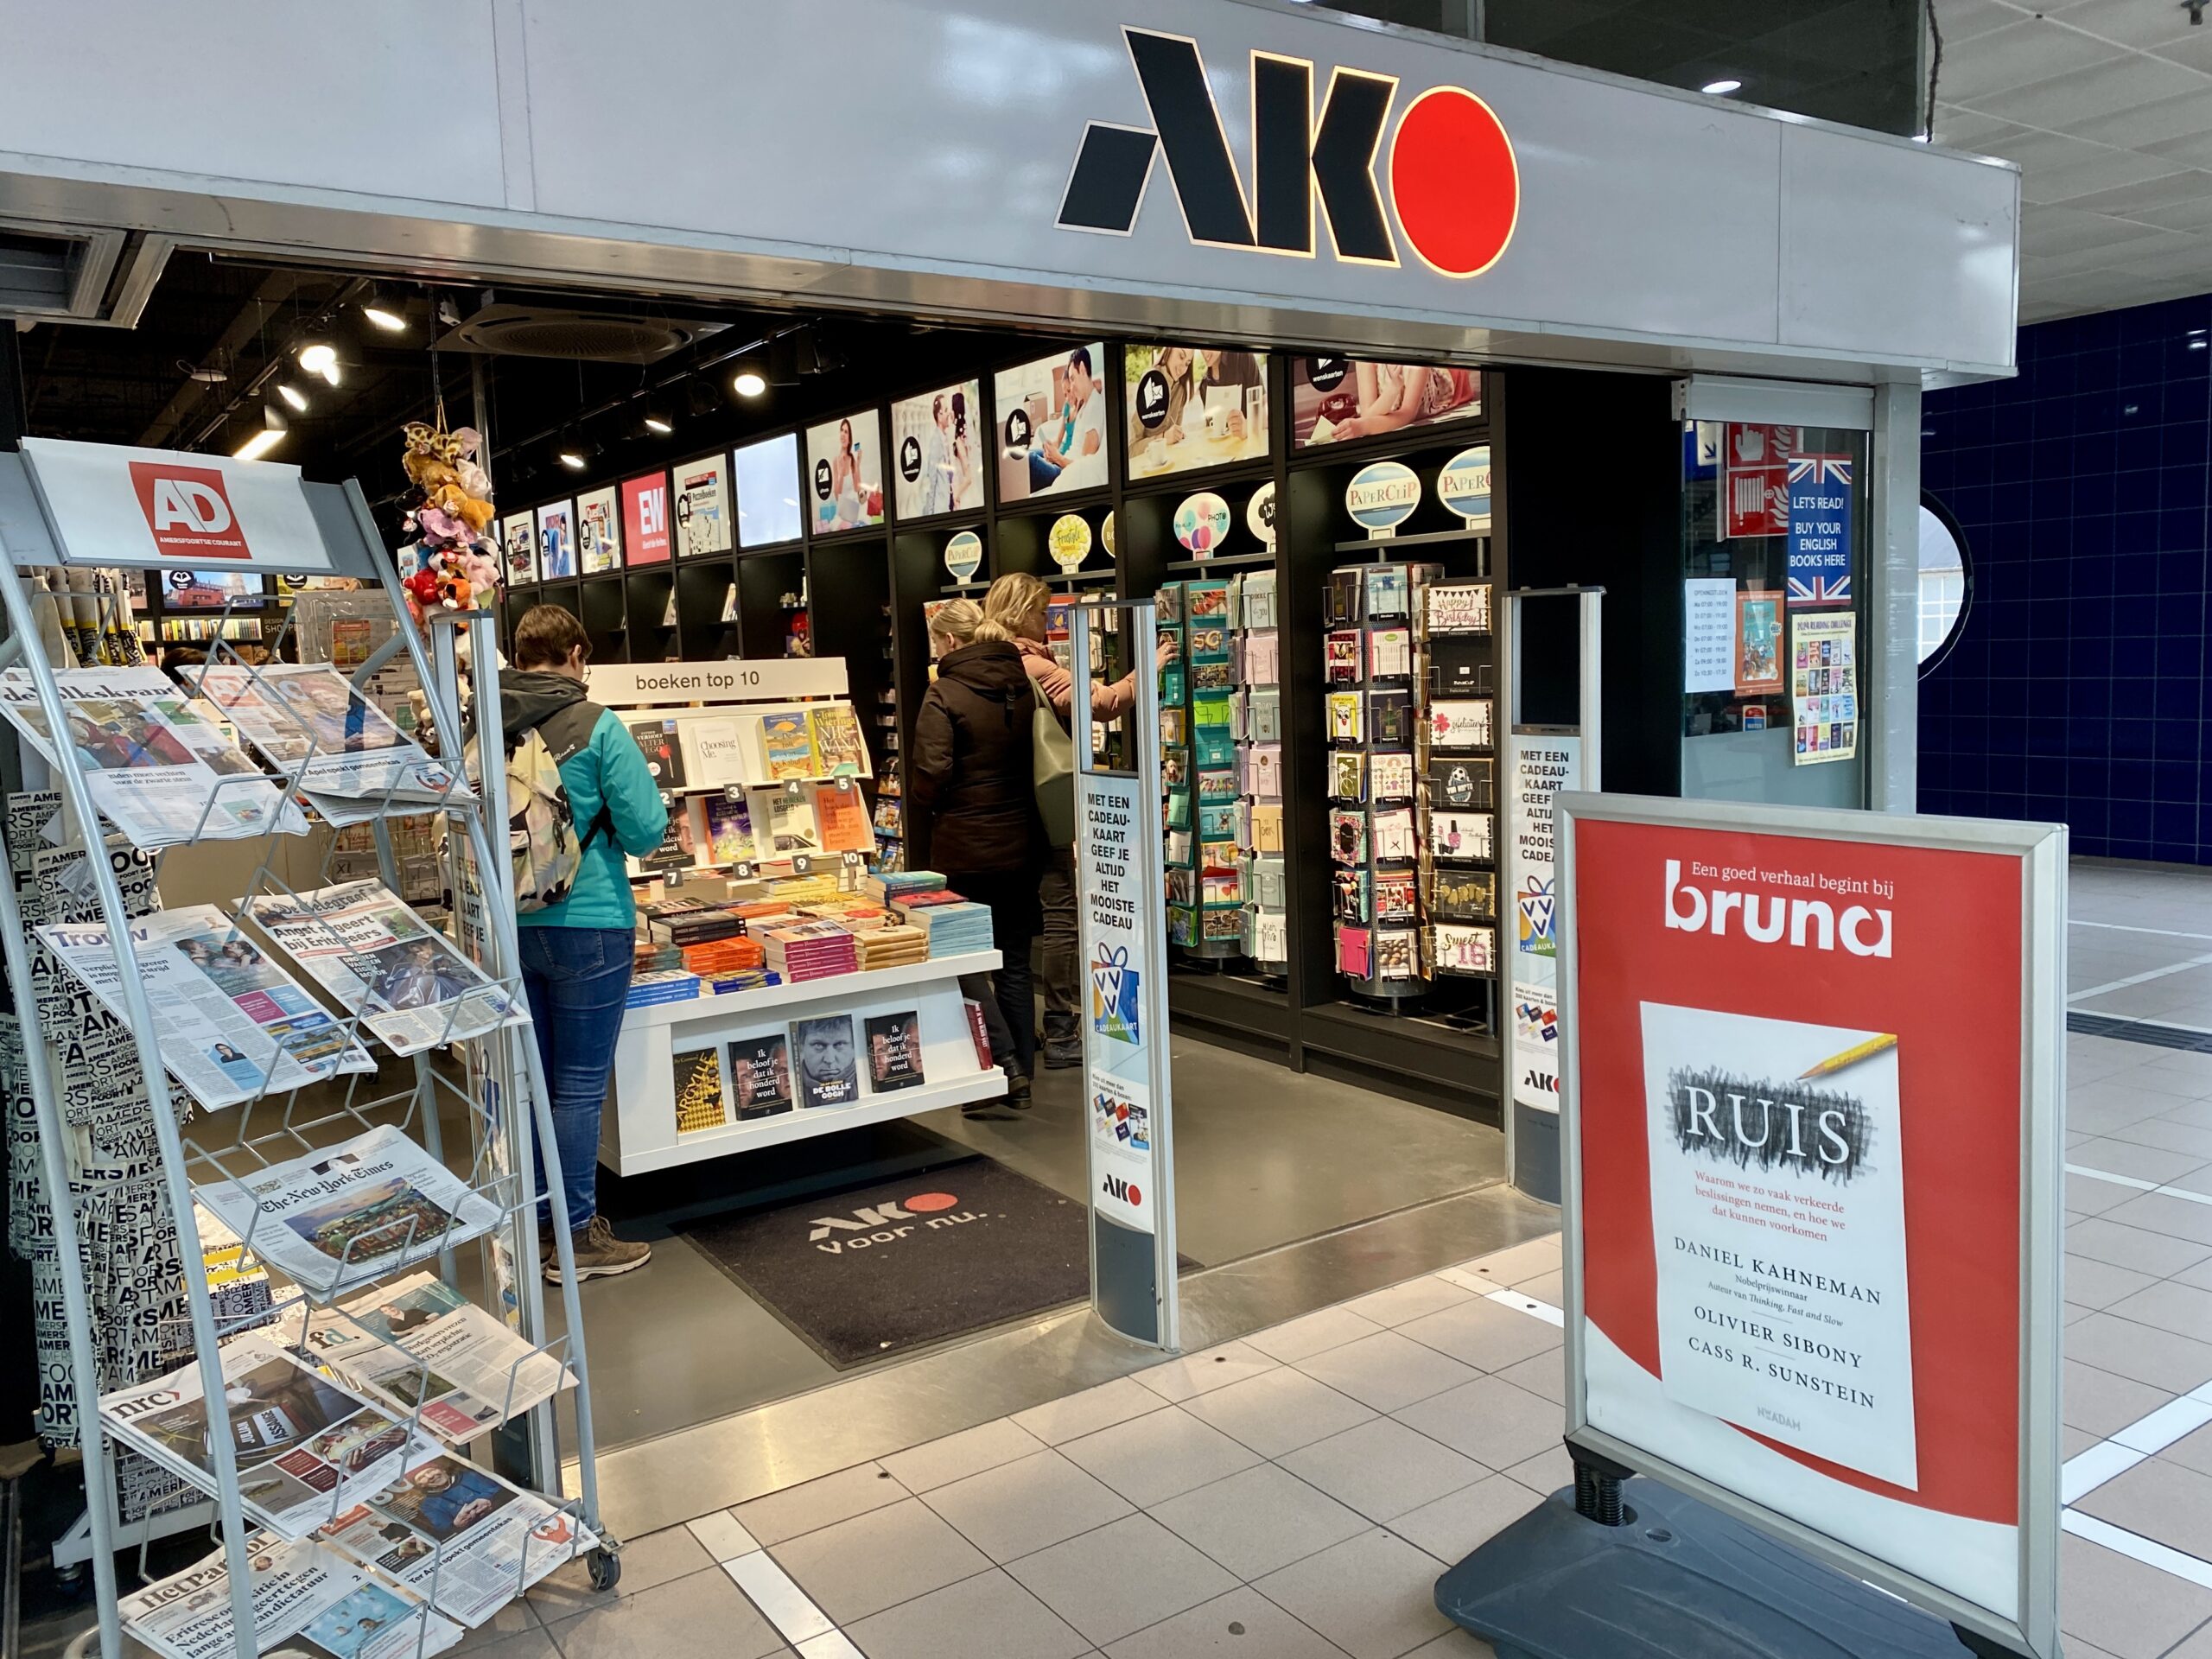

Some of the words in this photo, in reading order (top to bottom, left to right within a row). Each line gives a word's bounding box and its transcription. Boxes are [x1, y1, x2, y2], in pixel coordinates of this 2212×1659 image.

[1053, 24, 1519, 278] AKO
[1313, 369, 1344, 382] wenskaarten
[154, 478, 232, 533] AD
[1793, 497, 1815, 510] LET'S
[1818, 497, 1843, 510] READ!
[1796, 522, 1813, 534] BUY
[1816, 522, 1840, 534] YOUR
[159, 537, 212, 545] AMERSFOORTSE
[1800, 538, 1837, 550] ENGLISH
[1790, 555, 1822, 567] BOOKS
[1825, 554, 1846, 566] HERE
[636, 674, 701, 690] boeken
[708, 672, 734, 689] top
[741, 671, 760, 685] 10
[700, 739, 737, 750] Choosing
[1520, 750, 1541, 760] MET
[1545, 751, 1569, 762] EEN
[1520, 765, 1569, 777] CADEAU-
[728, 786, 740, 798] 3
[788, 782, 798, 793] 4
[838, 779, 849, 790] 5
[1525, 779, 1563, 791] KAART
[660, 792, 671, 804] 2
[1087, 793, 1105, 806] MET
[1109, 796, 1129, 809] EEN
[1522, 793, 1551, 804] GEEF
[1089, 810, 1130, 826] CADEAU-
[1527, 808, 1553, 819] ALTIJ
[1093, 827, 1125, 843] KAART
[659, 844, 678, 853] word
[1091, 844, 1115, 858] GEEF
[1118, 849, 1129, 861] JE
[797, 858, 807, 869] 9
[843, 852, 857, 863] 10
[738, 865, 748, 876] 8
[1096, 861, 1125, 877] ALTIJD
[668, 873, 677, 885] 7
[1101, 880, 1119, 893] HET
[1692, 862, 1718, 877] Een
[1722, 866, 1757, 882] goed
[1760, 870, 1815, 887] verhaal
[1820, 874, 1868, 894] begint
[1873, 880, 1894, 899] bij
[1090, 893, 1135, 913] MOOISTE
[1665, 859, 1892, 958] bruna
[273, 925, 318, 938] Angst
[318, 915, 375, 934] rgeert
[1093, 911, 1132, 931] CADEAU
[283, 938, 308, 950] bij
[308, 928, 382, 947] Eritreërs
[1443, 932, 1482, 950] Sweet
[1457, 943, 1486, 967] 16
[891, 1025, 899, 1033] Ik
[1096, 1022, 1138, 1033] CADEAUKAART
[882, 1034, 904, 1044] beloof
[903, 1033, 911, 1042] je
[757, 1048, 766, 1058] Ik
[887, 1044, 899, 1052] dat
[747, 1060, 771, 1071] beloof
[770, 1058, 779, 1067] je
[885, 1051, 912, 1063] honderd
[891, 1061, 908, 1071] word
[753, 1070, 766, 1079] dat
[676, 1052, 710, 1123] ARGYLLE
[749, 1077, 780, 1090] honderd
[812, 1086, 823, 1095] DE
[825, 1083, 851, 1091] BOLLE
[756, 1087, 776, 1098] word
[1685, 1085, 1850, 1165] RUIS
[261, 1199, 289, 1213] The
[286, 1185, 321, 1204] New
[321, 1173, 356, 1193] York
[352, 1160, 394, 1179] Times
[1103, 1173, 1141, 1206] AKO
[1694, 1170, 1734, 1188] Waarom
[1738, 1182, 1751, 1193] we
[1753, 1185, 1765, 1195] zo
[1768, 1187, 1791, 1202] vaak
[1794, 1193, 1845, 1214] verkeerde
[1695, 1185, 1751, 1209] beslissingen
[1754, 1201, 1791, 1218] nemen,
[1793, 1211, 1807, 1222] en
[1808, 1211, 1828, 1226] hoe
[1831, 1220, 1846, 1230] we
[809, 1192, 958, 1241] AKO
[1712, 1205, 1727, 1217] dat
[1729, 1208, 1766, 1227] kunnen
[1770, 1220, 1827, 1242] voorkomen
[1675, 1236, 1744, 1269] DANIEL
[1752, 1259, 1882, 1306] KAHNEMAN
[1735, 1274, 1808, 1302] Nobelprijswinnaar
[1707, 1281, 1732, 1295] Auteur
[1733, 1289, 1748, 1300] van
[1748, 1293, 1786, 1313] Thinking,
[1787, 1303, 1804, 1317] Fast
[1805, 1308, 1822, 1321] and
[1824, 1313, 1844, 1327] Slow
[1694, 1306, 1775, 1343] OLIVIER
[1783, 1333, 1863, 1369] SIBONY
[1688, 1337, 1734, 1363] CASS
[1742, 1353, 1760, 1372] R.
[1769, 1363, 1875, 1409] SUNSTEIN
[109, 1391, 173, 1420] nrc
[261, 1410, 290, 1440] ASSANGE
[408, 1573, 423, 1585] Ter
[442, 1548, 465, 1567] spekt
[463, 1516, 513, 1551] gemeentekas
[138, 1580, 190, 1610] Het
[185, 1535, 269, 1588] Parol
[286, 1566, 319, 1592] tegen
[187, 1633, 226, 1659] lange
[272, 1572, 328, 1612] dictatuur
